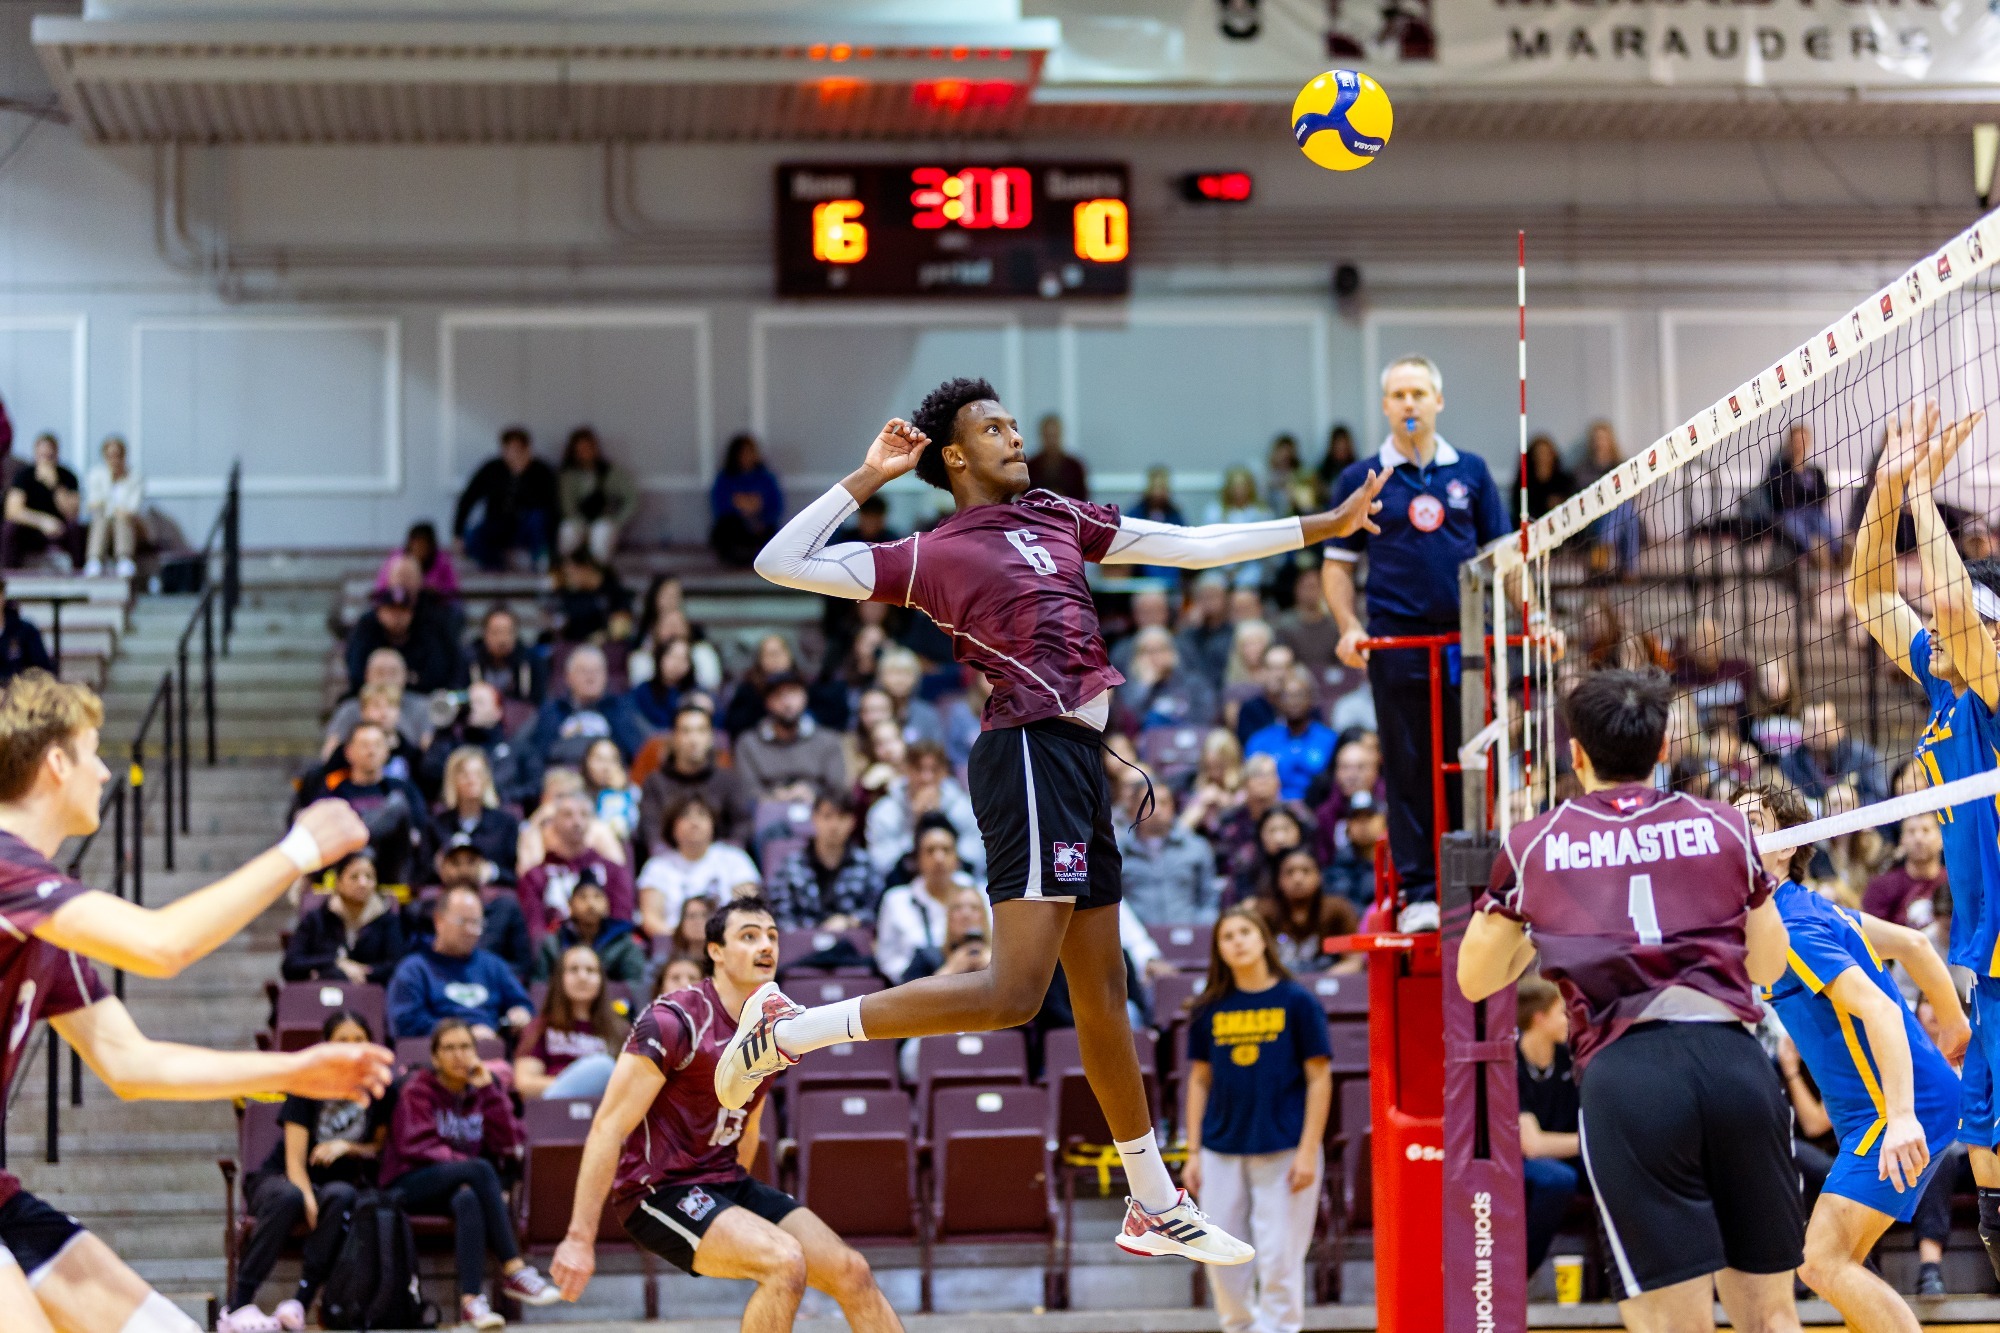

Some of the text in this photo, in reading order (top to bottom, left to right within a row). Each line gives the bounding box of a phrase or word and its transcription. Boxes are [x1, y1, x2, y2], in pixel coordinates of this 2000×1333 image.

[1507, 25, 1933, 60] MARAUDERS
[1004, 529, 1057, 576] 6
[1545, 817, 1720, 872] McMASTER
[1628, 873, 1663, 946] 1
[1471, 1191, 1495, 1258] sports
